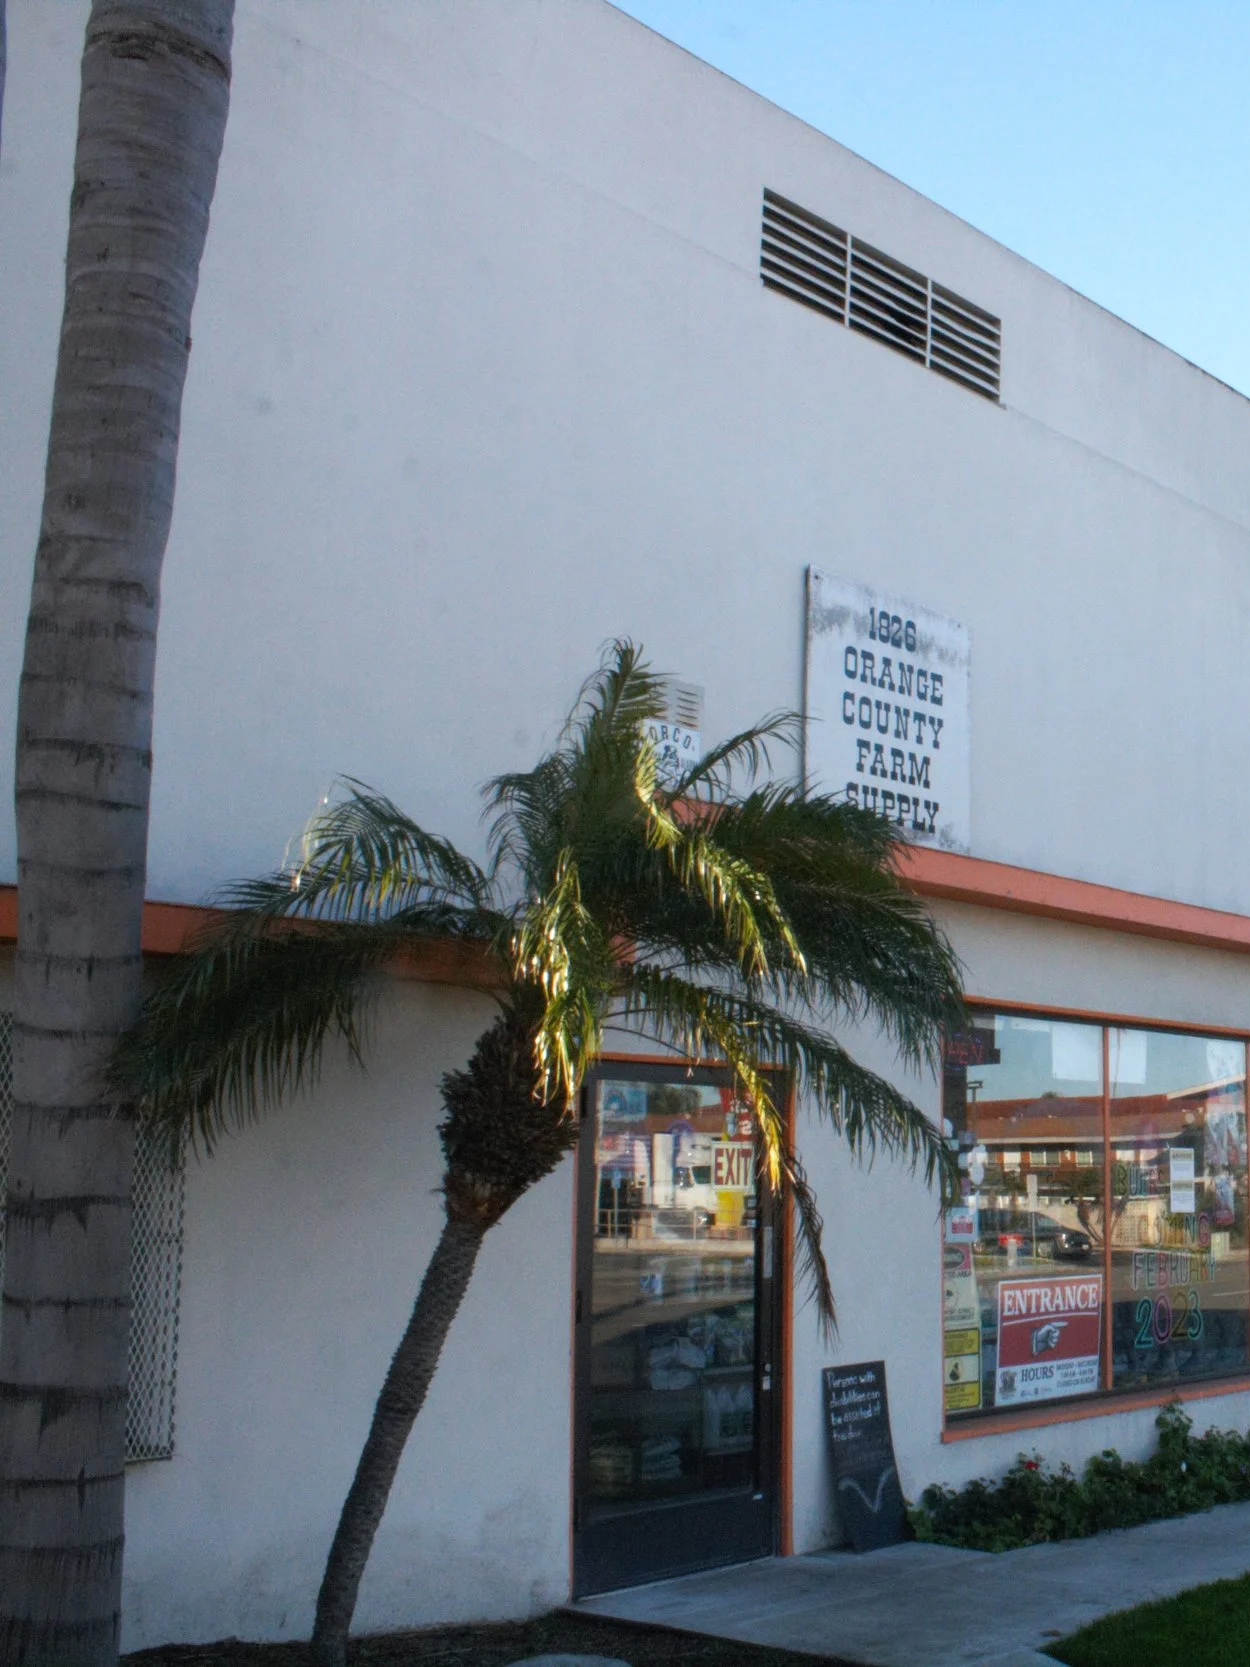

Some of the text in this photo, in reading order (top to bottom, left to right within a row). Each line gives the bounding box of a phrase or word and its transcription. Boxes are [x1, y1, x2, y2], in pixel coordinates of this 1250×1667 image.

[869, 606, 917, 652] 1826
[844, 646, 943, 706] ORANGE
[842, 691, 944, 749] COUNTY
[856, 738, 931, 789] FARM
[846, 781, 939, 834] SUPPLY
[715, 1147, 752, 1186] EXIT
[1131, 1249, 1217, 1290] FEBRUARY
[1002, 1282, 1099, 1317] ENTRANCE
[1134, 1289, 1204, 1349] 2023
[1021, 1364, 1055, 1382] HOURS
